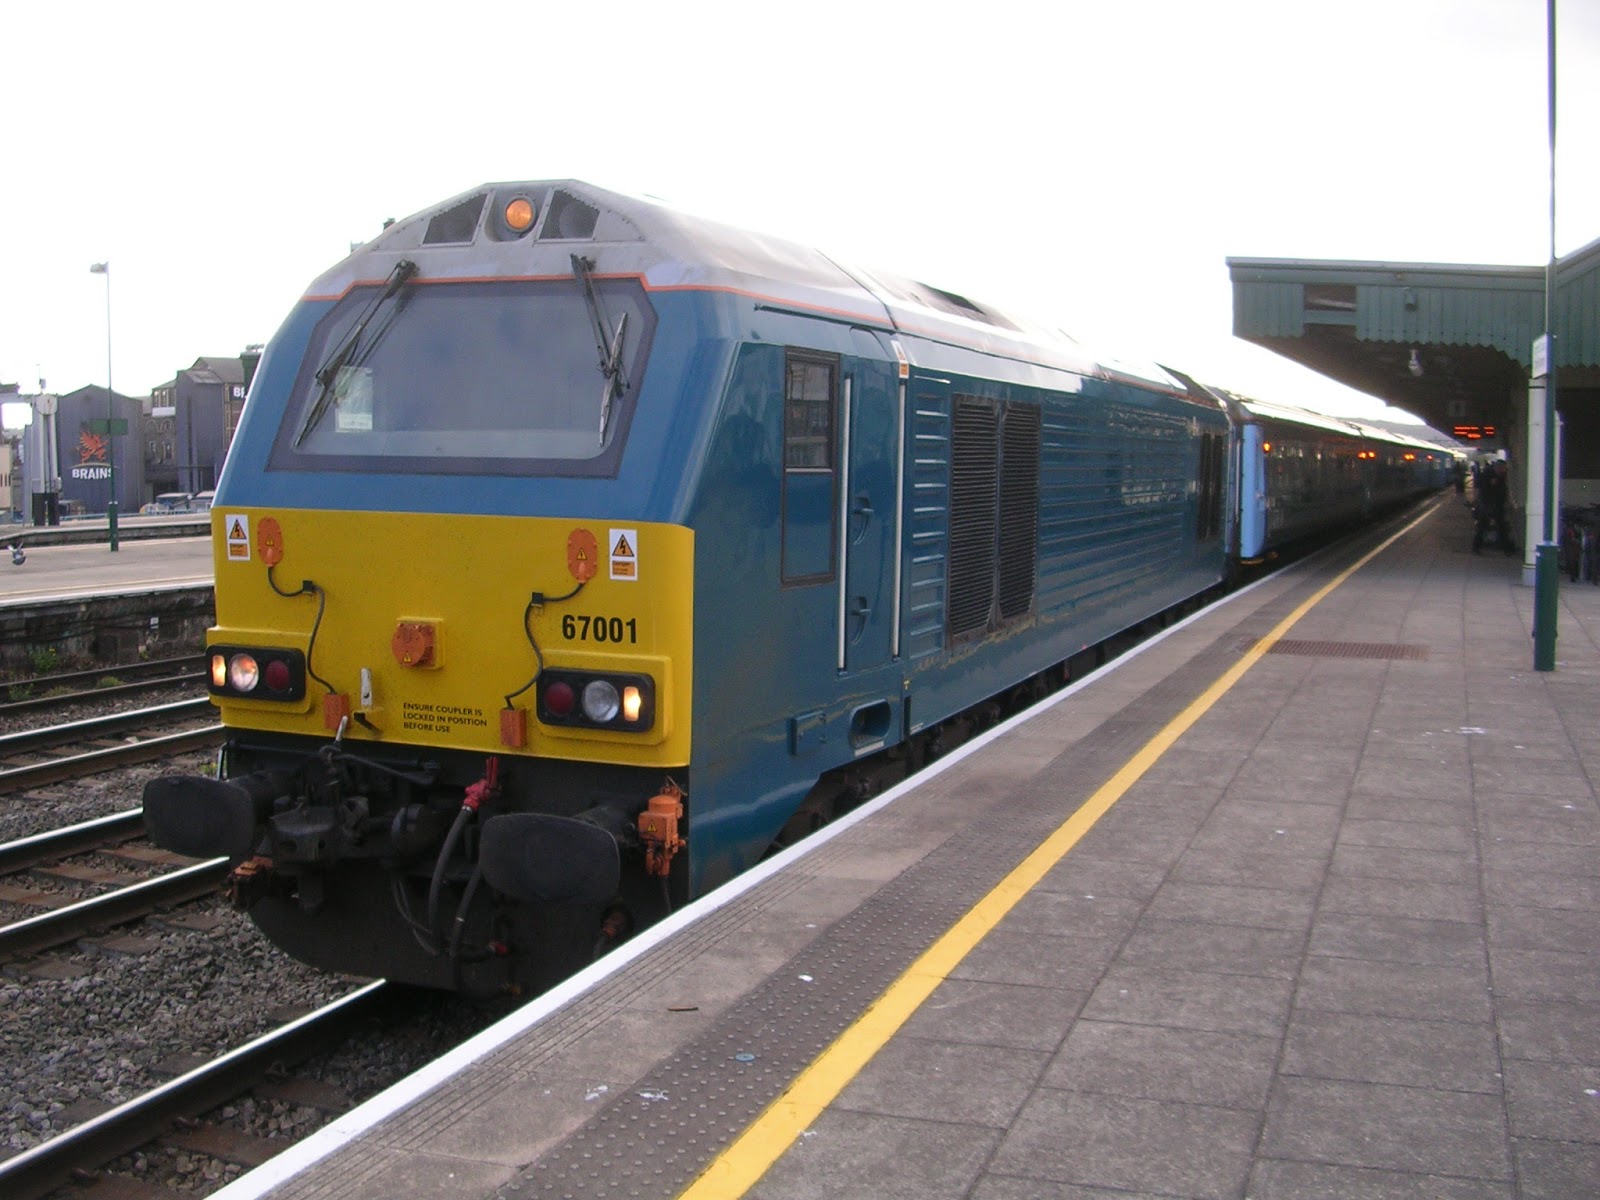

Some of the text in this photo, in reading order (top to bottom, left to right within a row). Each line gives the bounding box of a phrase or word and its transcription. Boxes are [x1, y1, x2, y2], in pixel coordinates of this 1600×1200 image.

[562, 614, 637, 644] 67001
[403, 702, 434, 712] ENSURE
[435, 705, 473, 716] COUPLER
[403, 712, 435, 722] LOCKED
[447, 716, 487, 727] POSITION
[403, 722, 451, 733] BEFORE USE
